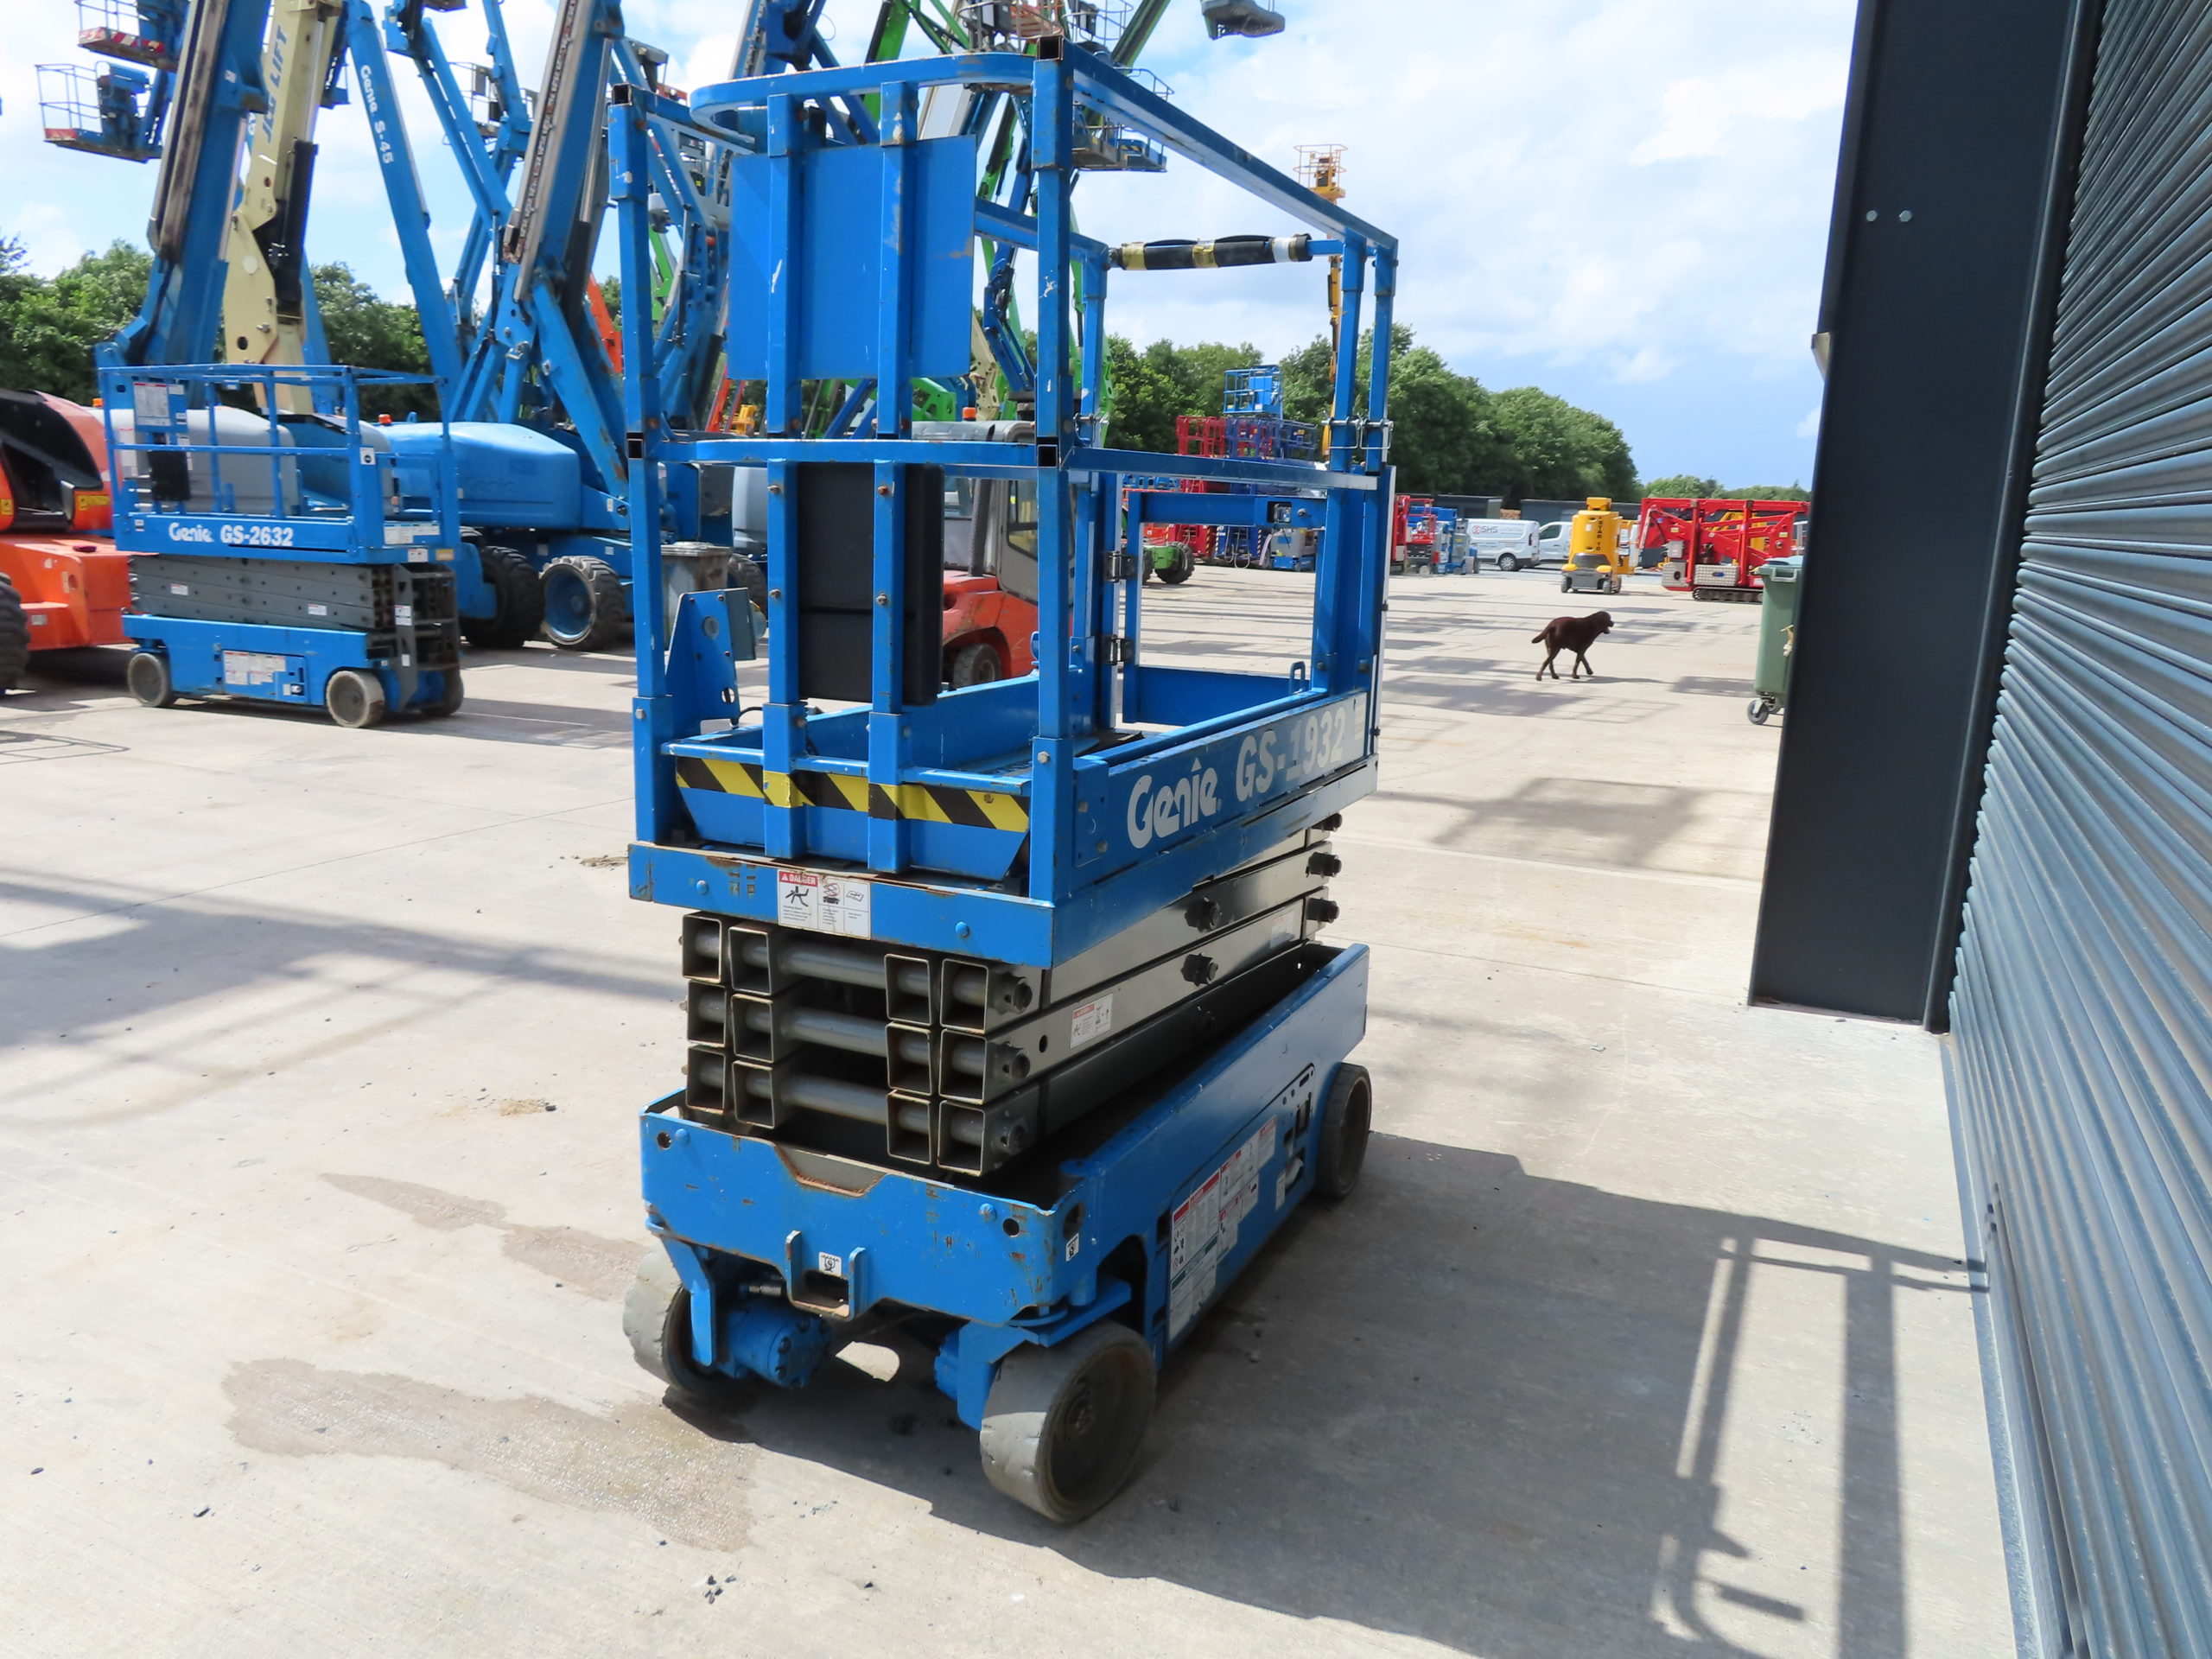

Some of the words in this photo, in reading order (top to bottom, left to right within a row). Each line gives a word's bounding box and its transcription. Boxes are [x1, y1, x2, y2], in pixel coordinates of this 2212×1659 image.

[269, 25, 287, 89] LIFT
[360, 64, 378, 113] Genie
[374, 120, 394, 164] S-45
[168, 522, 214, 543] Genie
[220, 524, 294, 546] GS-2632
[1127, 758, 1218, 849] Genie
[1236, 707, 1346, 802] GS-1932
